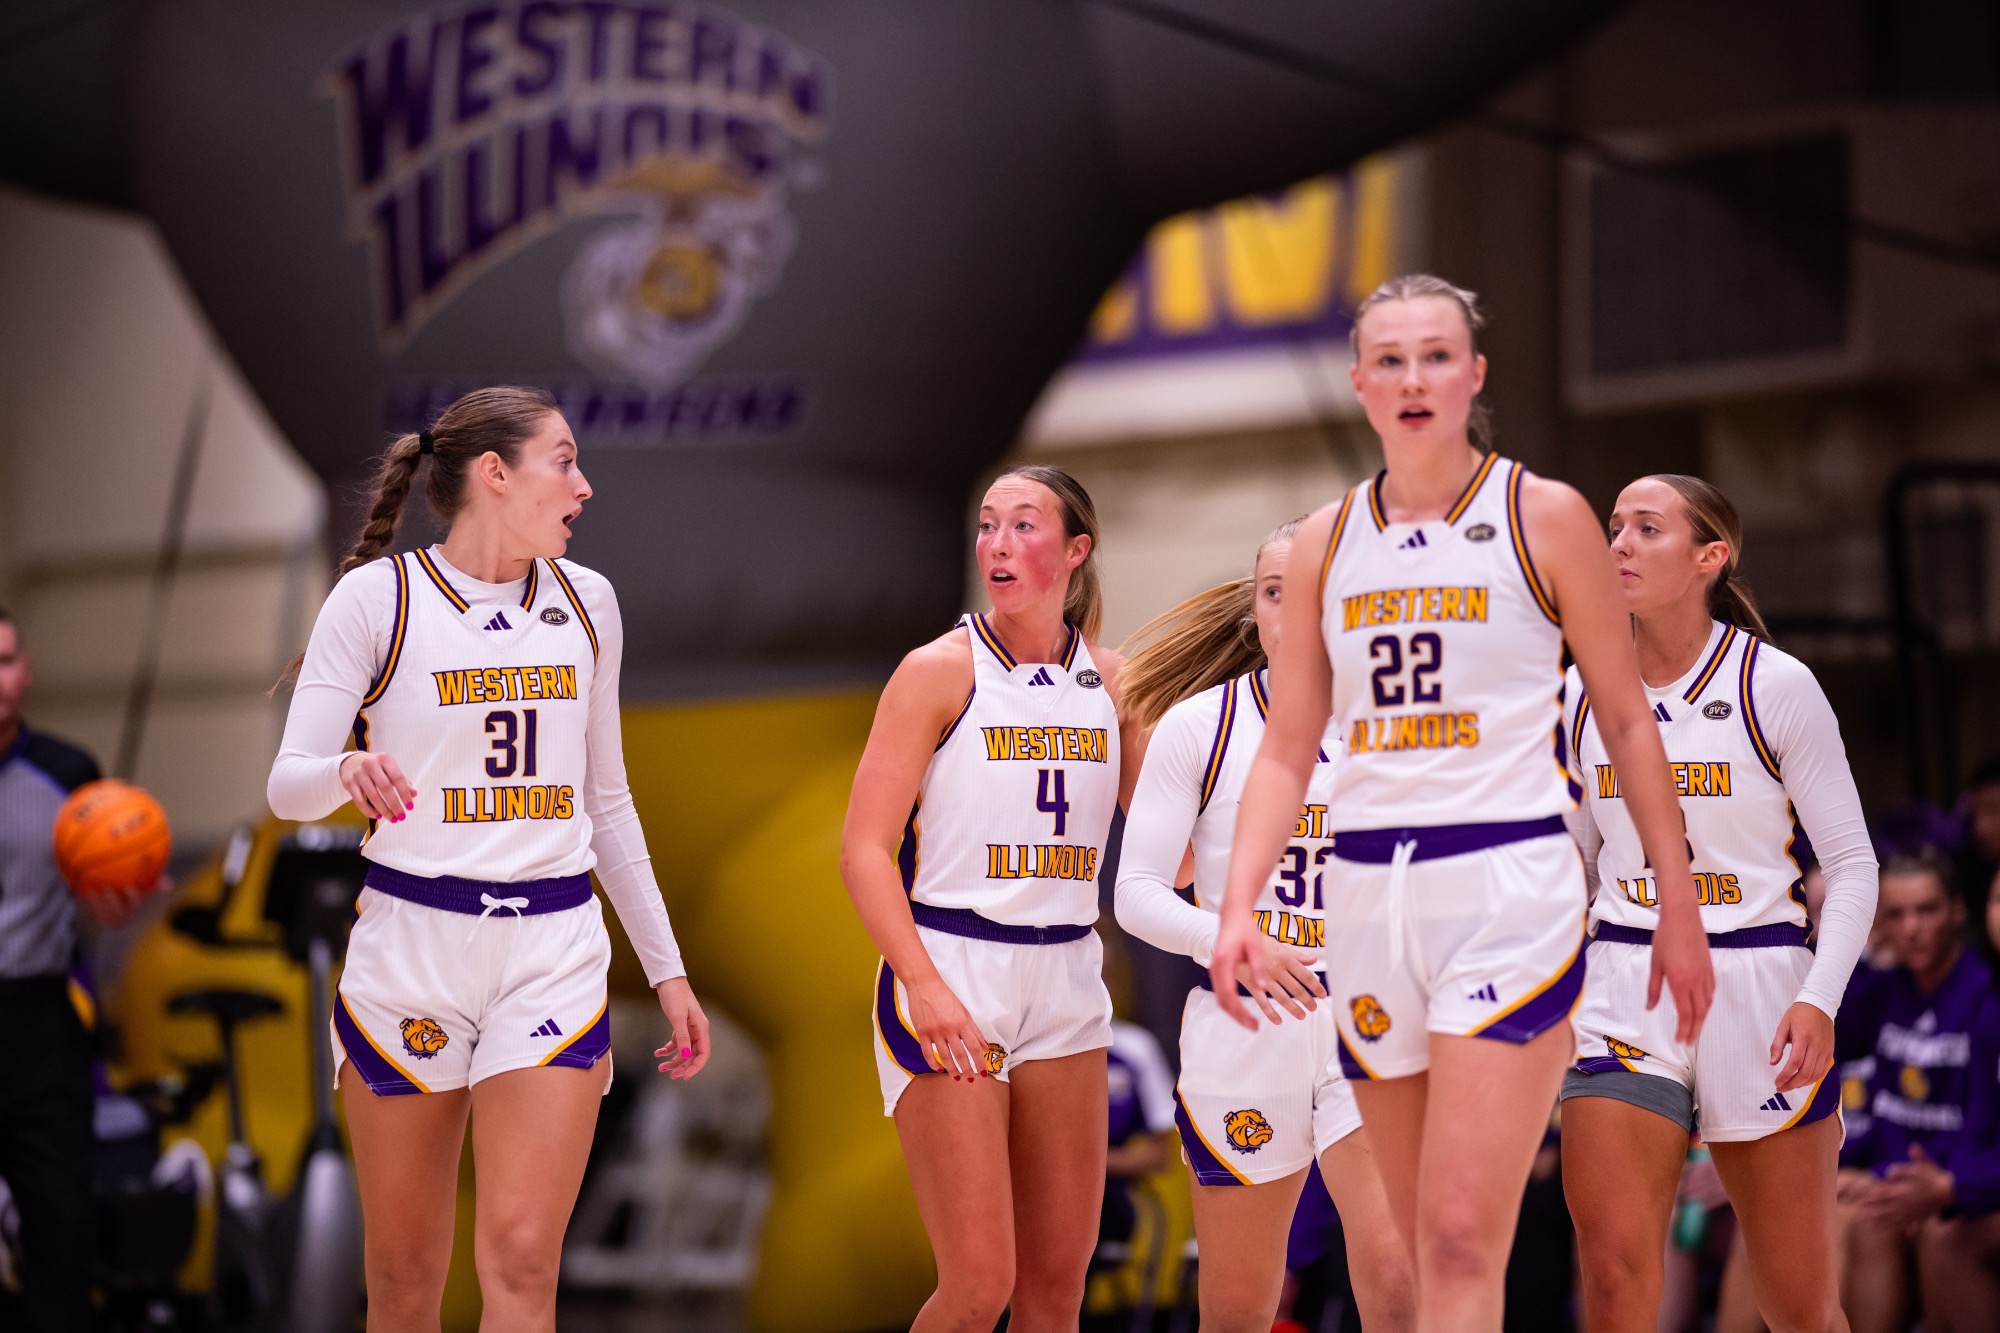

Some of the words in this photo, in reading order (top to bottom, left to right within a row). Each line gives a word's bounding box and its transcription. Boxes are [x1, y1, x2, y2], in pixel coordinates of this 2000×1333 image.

[330, 0, 832, 195] WESTERN
[1342, 587, 1489, 633] WESTERN
[430, 665, 578, 706] WESTERN
[1369, 632, 1442, 707] 22
[484, 708, 538, 778] 31
[980, 727, 1107, 764] WESTERN
[1595, 762, 1732, 798] WERN
[441, 785, 574, 823] ILLINOIS
[1036, 768, 1070, 837] 4
[985, 844, 1097, 882] ILLINOIS
